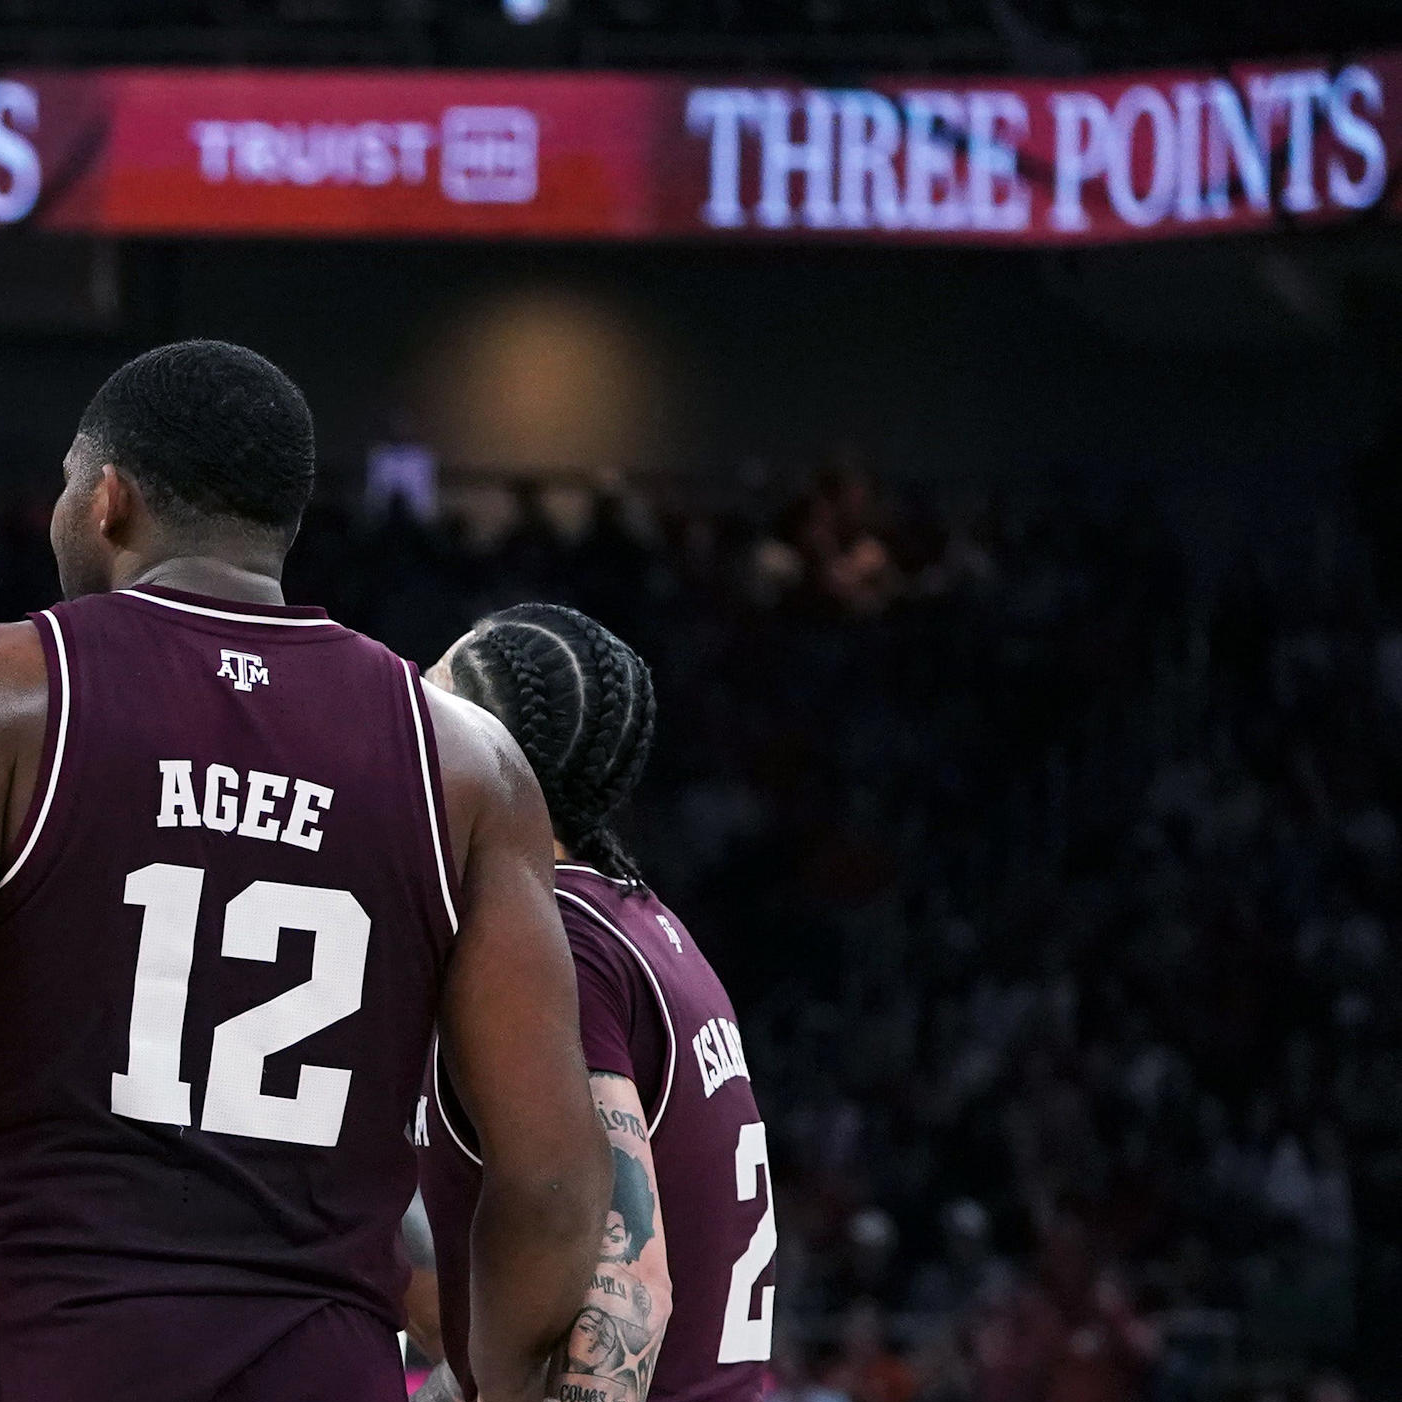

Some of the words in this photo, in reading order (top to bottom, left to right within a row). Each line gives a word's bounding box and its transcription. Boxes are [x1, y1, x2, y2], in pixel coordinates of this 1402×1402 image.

[190, 121, 431, 186] TRUIST
[684, 86, 1030, 231] THREE
[1049, 64, 1387, 232] POINTS
[157, 760, 334, 852] AGEE
[111, 862, 372, 1147] 12
[717, 1122, 777, 1364] 2
